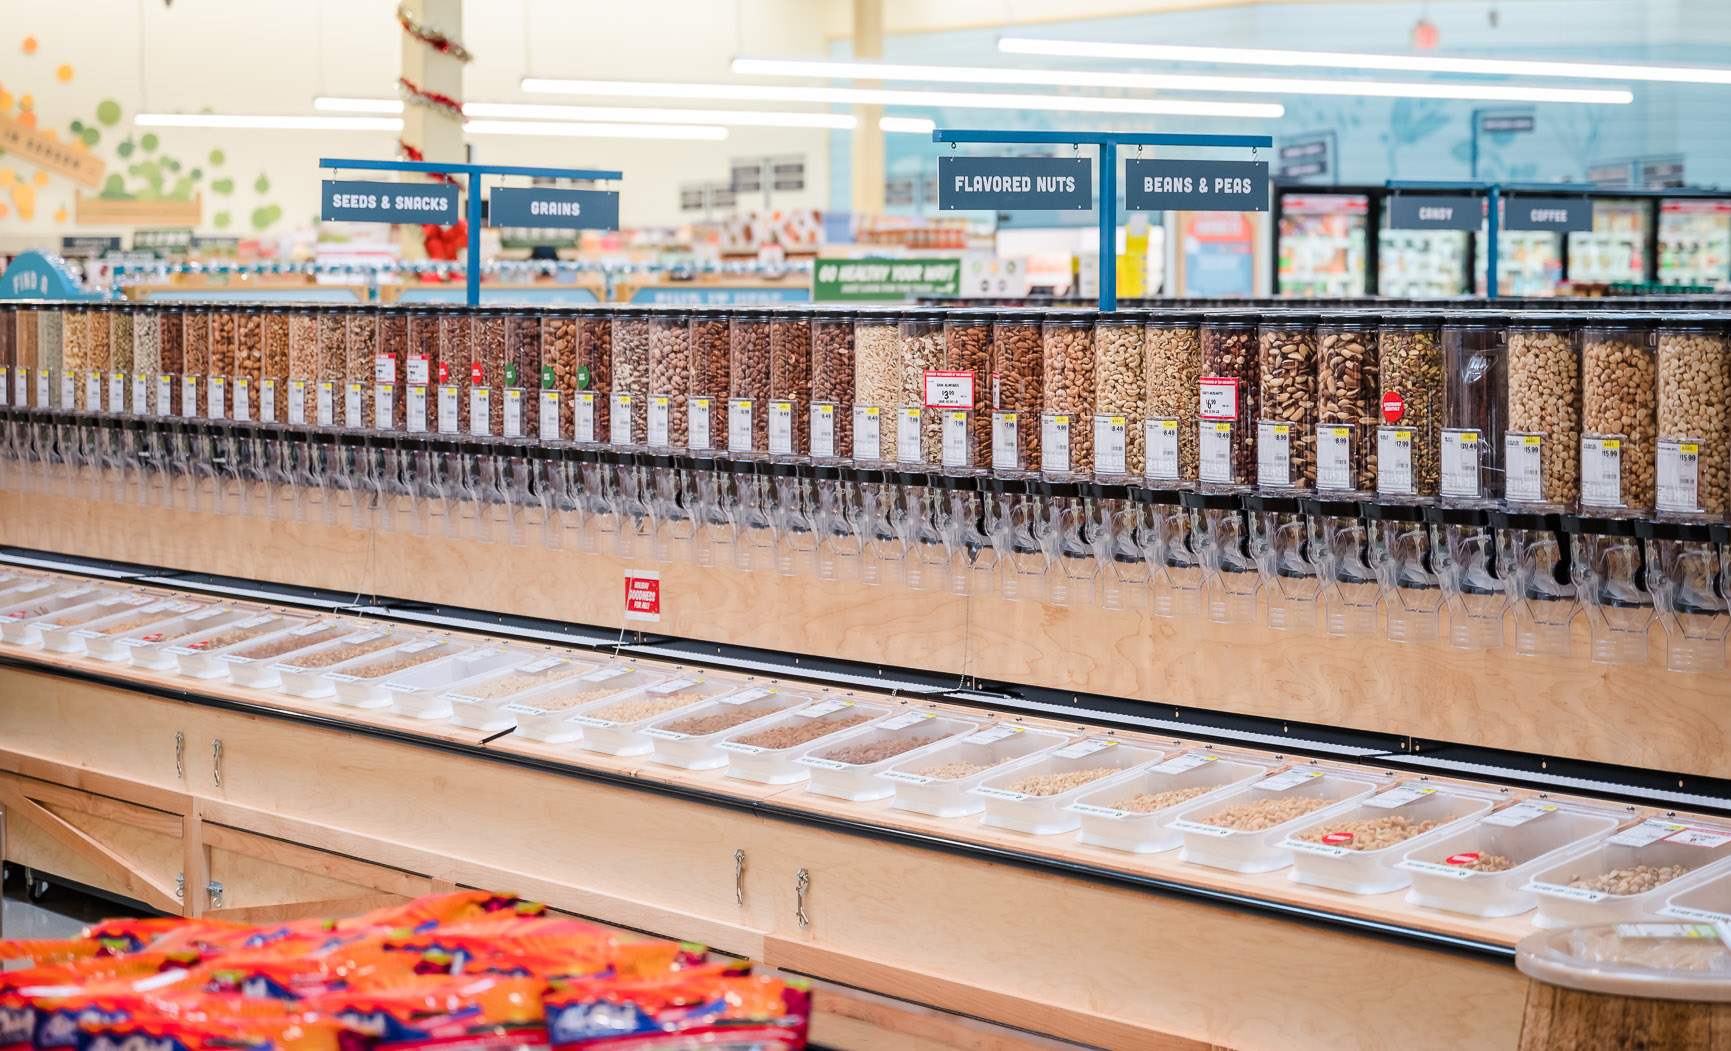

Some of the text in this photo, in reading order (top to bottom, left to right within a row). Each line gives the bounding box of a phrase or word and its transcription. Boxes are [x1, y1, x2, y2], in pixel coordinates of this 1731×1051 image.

[954, 175, 1076, 193] FLAVORED NUTS
[1143, 176, 1252, 194] BEANS & PEAS
[332, 193, 449, 212] SEEDS & SNACKS
[530, 200, 581, 217] GRAINS
[1418, 206, 1453, 221] CANDY
[1530, 209, 1568, 223] COFFEE
[13, 271, 37, 294] FIND
